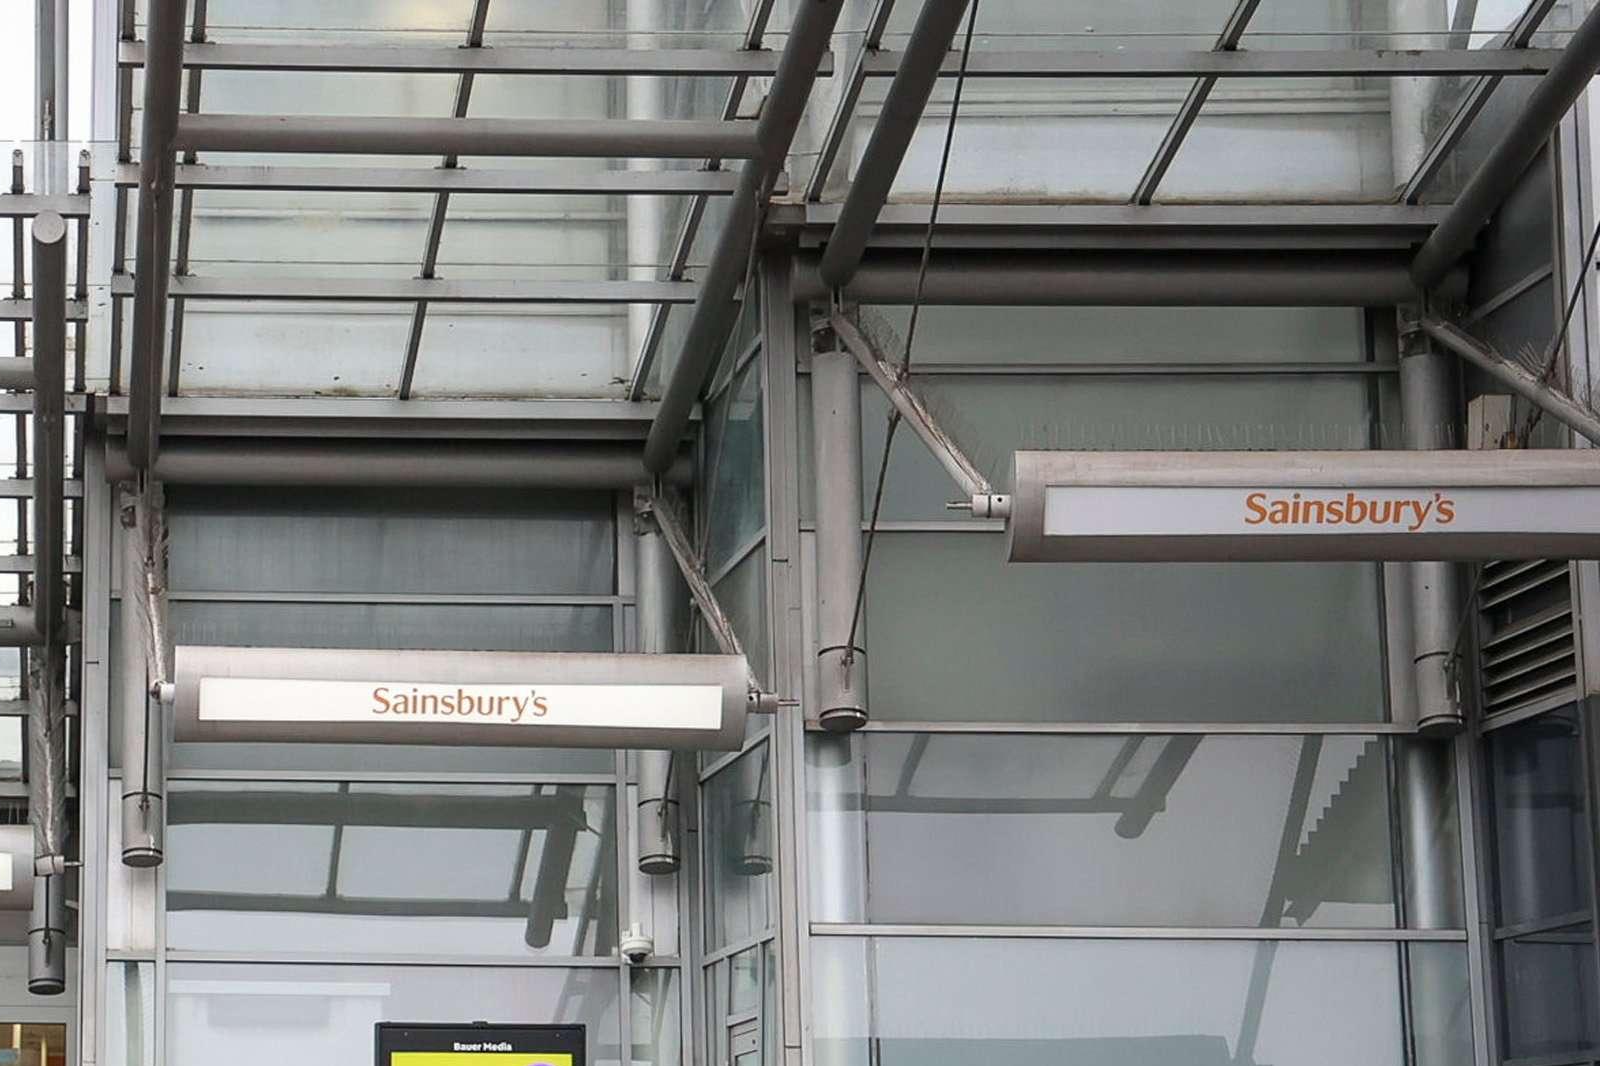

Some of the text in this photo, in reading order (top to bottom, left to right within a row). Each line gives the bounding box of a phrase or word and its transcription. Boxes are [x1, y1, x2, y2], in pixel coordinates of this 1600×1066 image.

[1244, 492, 1456, 532] Sainsbury's
[372, 687, 548, 722] Sainsbury's
[453, 1042, 512, 1052] Bauer Media
